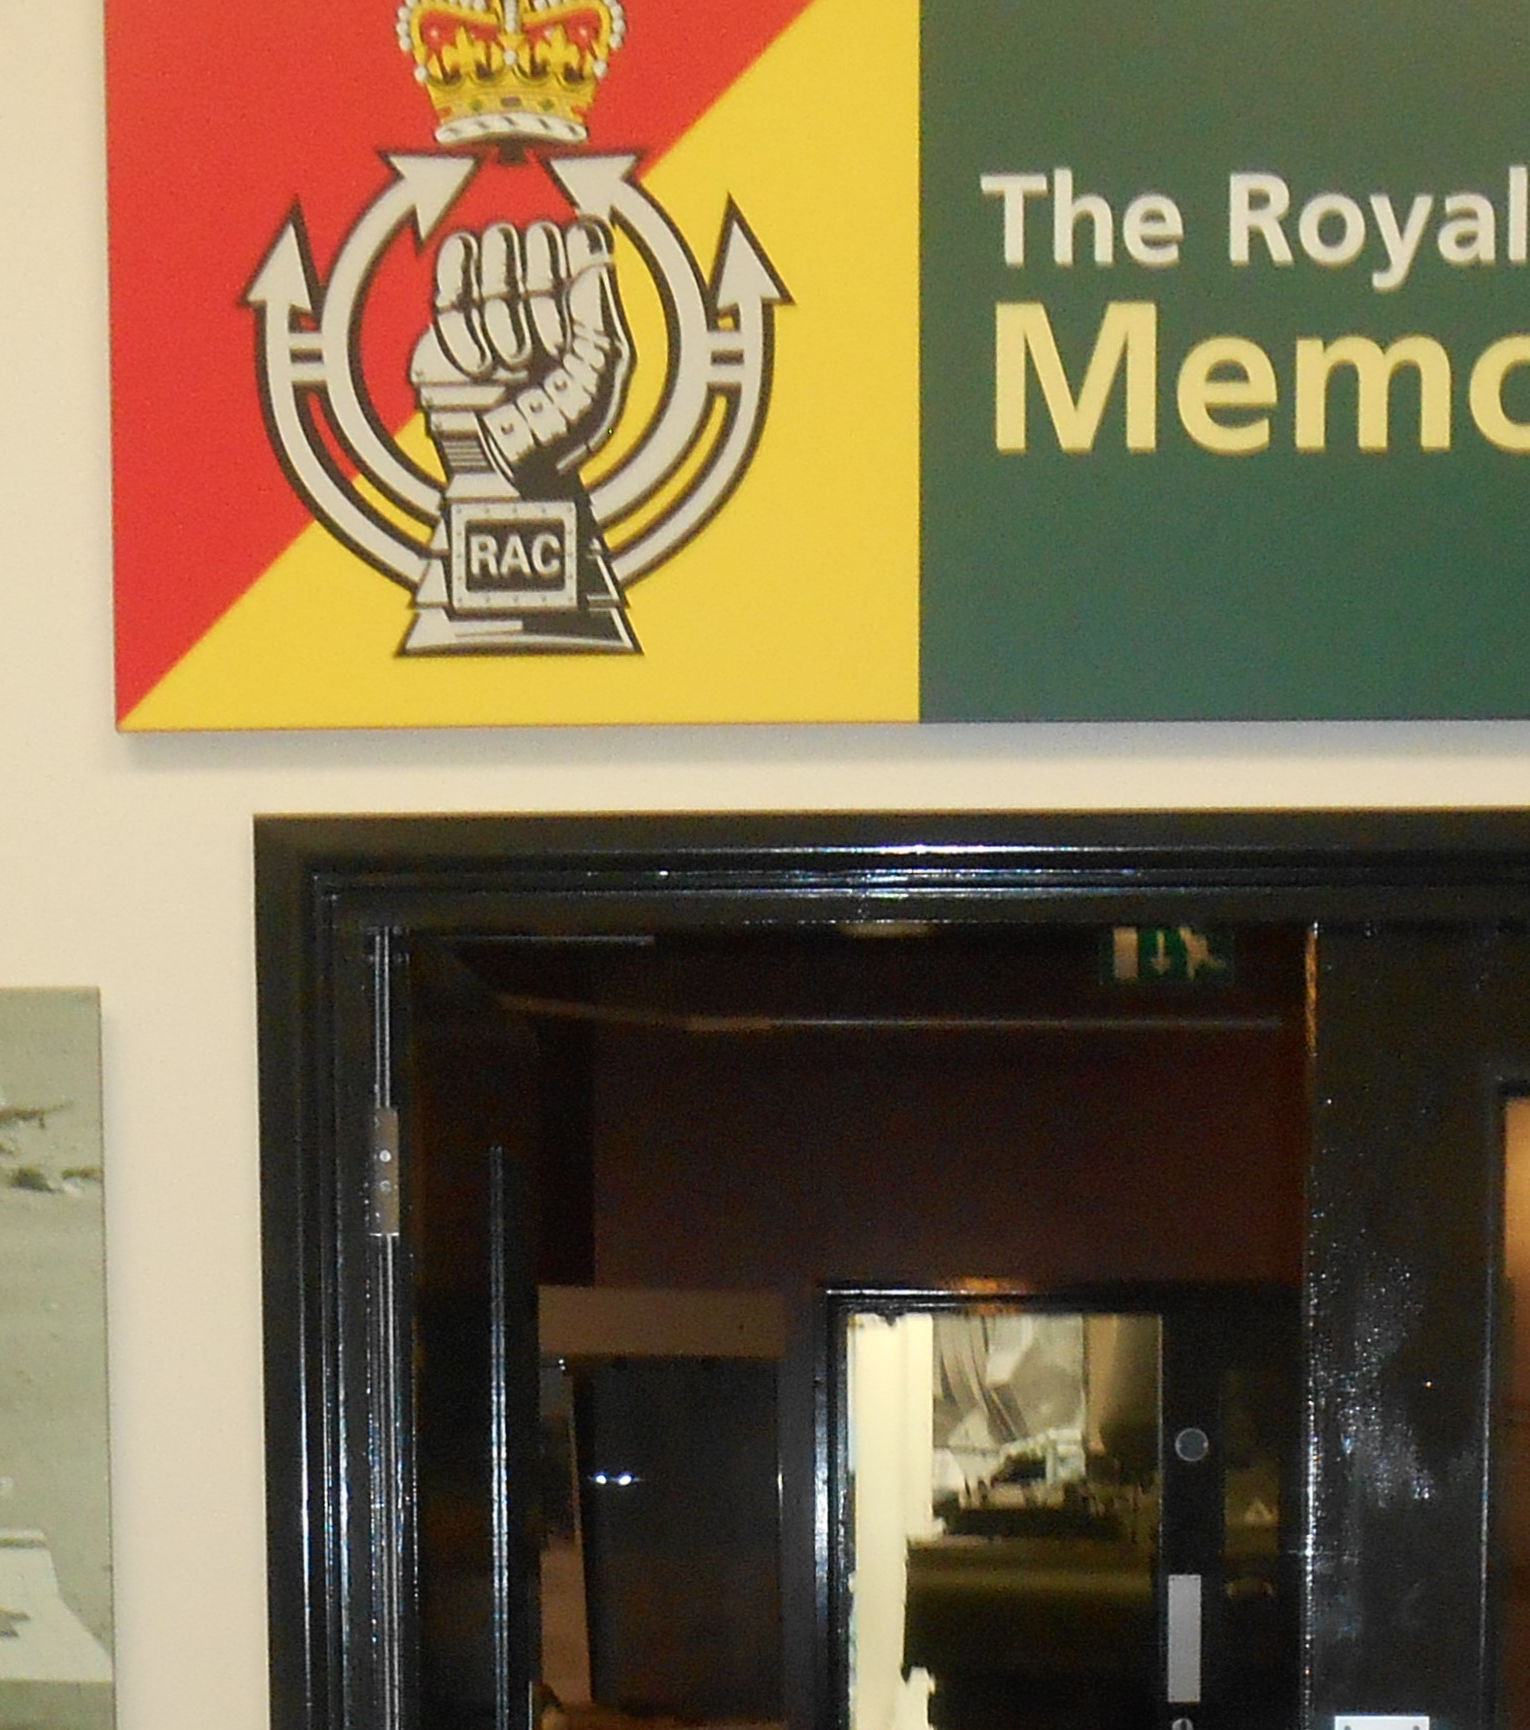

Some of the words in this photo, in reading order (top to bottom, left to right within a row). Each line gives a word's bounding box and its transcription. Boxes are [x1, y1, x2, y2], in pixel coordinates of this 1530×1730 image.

[980, 167, 1184, 266] The
[1228, 164, 1529, 290] Royal
[470, 534, 561, 578] RAC
